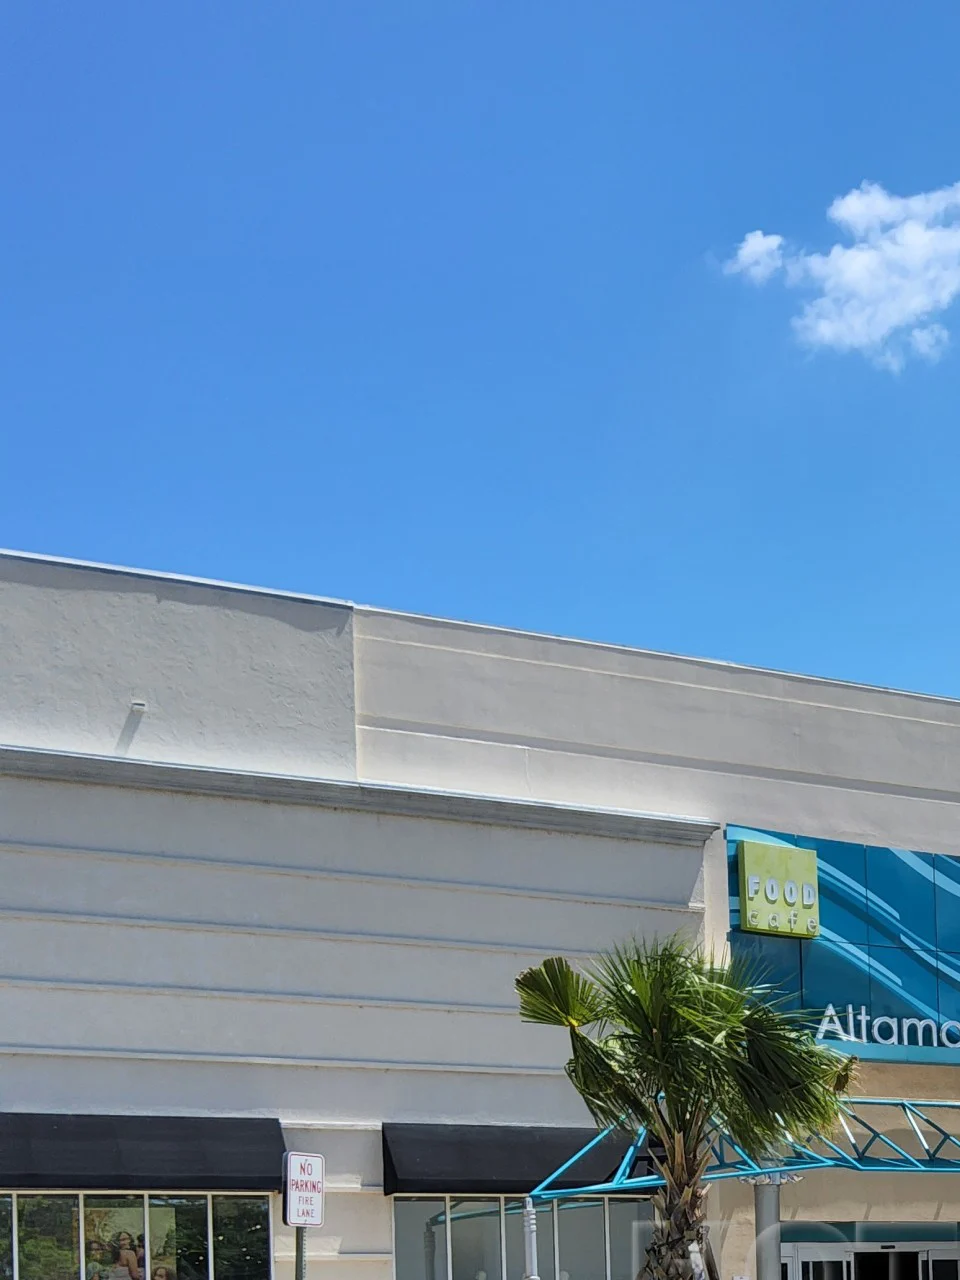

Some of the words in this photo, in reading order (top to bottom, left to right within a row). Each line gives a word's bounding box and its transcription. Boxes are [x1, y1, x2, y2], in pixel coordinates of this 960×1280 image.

[747, 874, 816, 907] FOOD
[747, 908, 818, 933] cafe
[299, 1162, 313, 1176] NO
[291, 1179, 322, 1193] PARKING
[298, 1195, 314, 1206] FIRE
[296, 1208, 315, 1218] LANE
